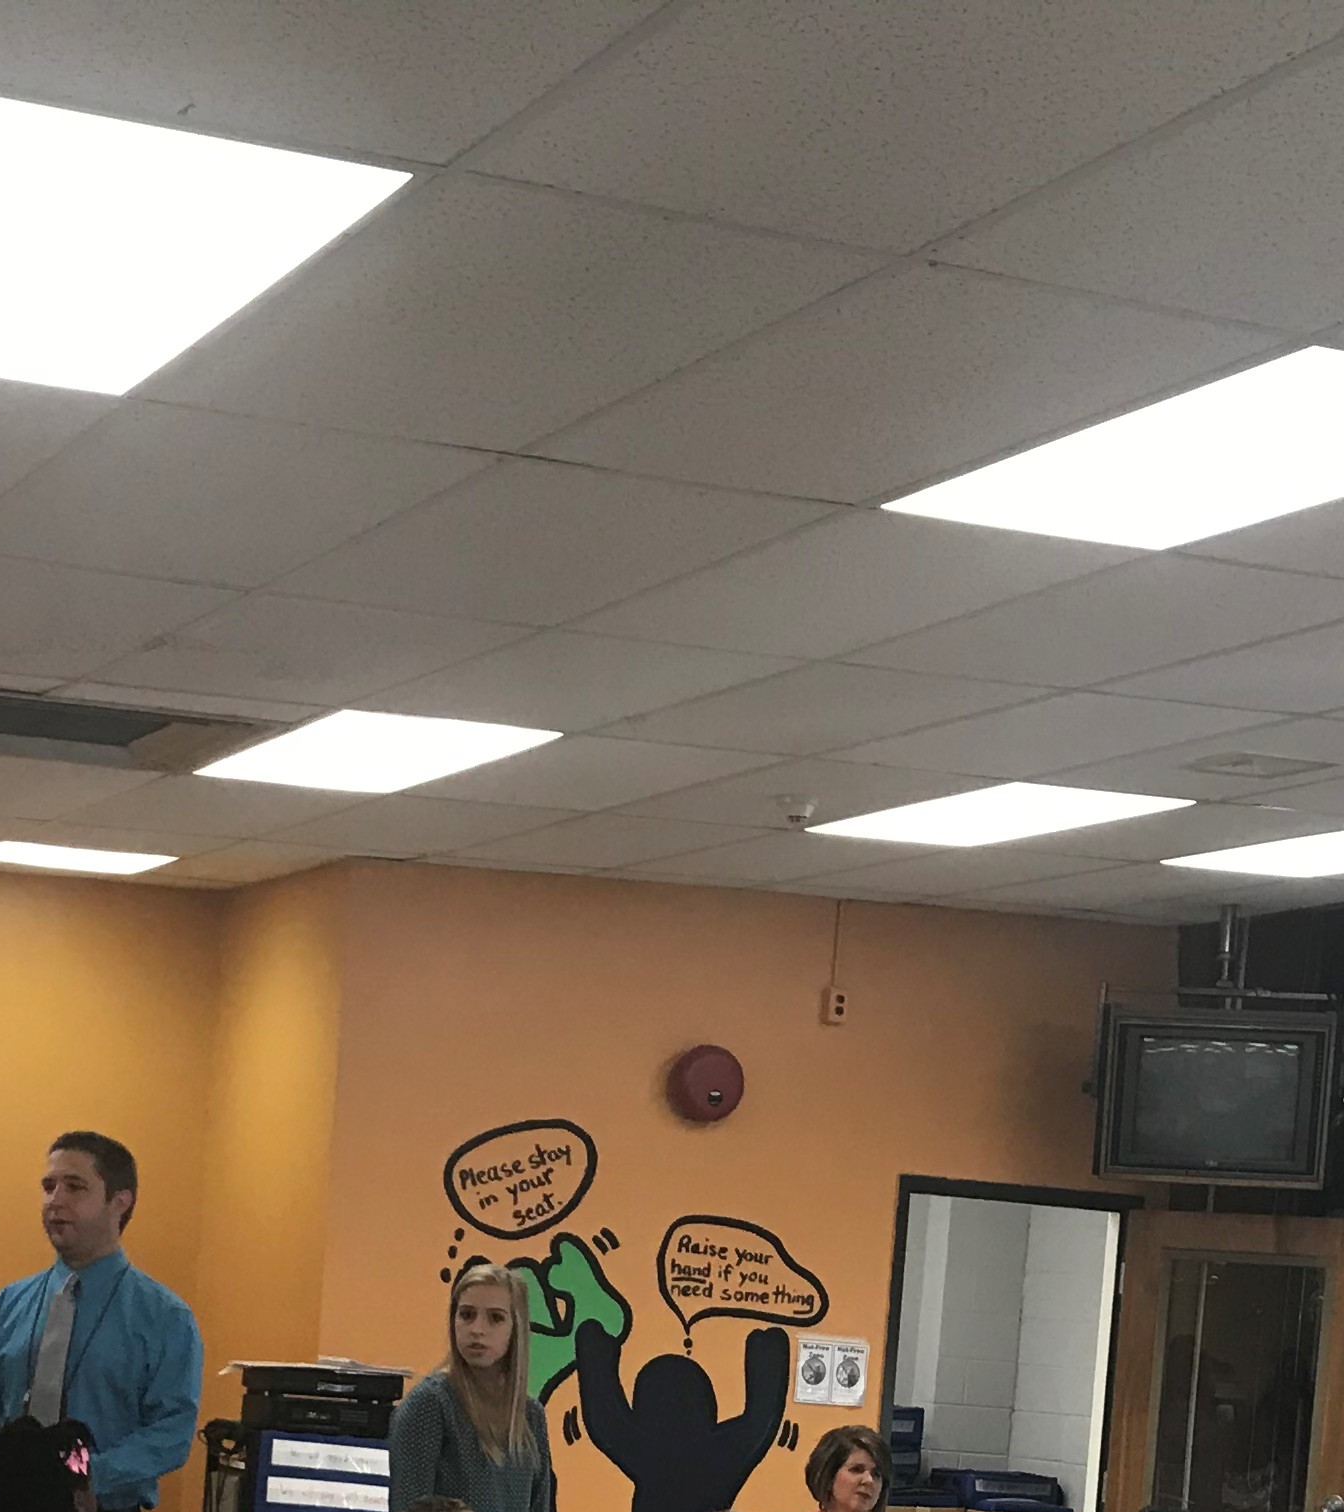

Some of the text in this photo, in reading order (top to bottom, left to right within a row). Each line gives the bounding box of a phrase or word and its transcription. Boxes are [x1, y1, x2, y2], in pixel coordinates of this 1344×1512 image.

[458, 1143, 572, 1190] Please stay
[476, 1167, 555, 1210] in your
[513, 1192, 563, 1228] seat.
[677, 1234, 774, 1267] Raise your
[670, 1258, 769, 1288] hand if you
[670, 1282, 714, 1299] need
